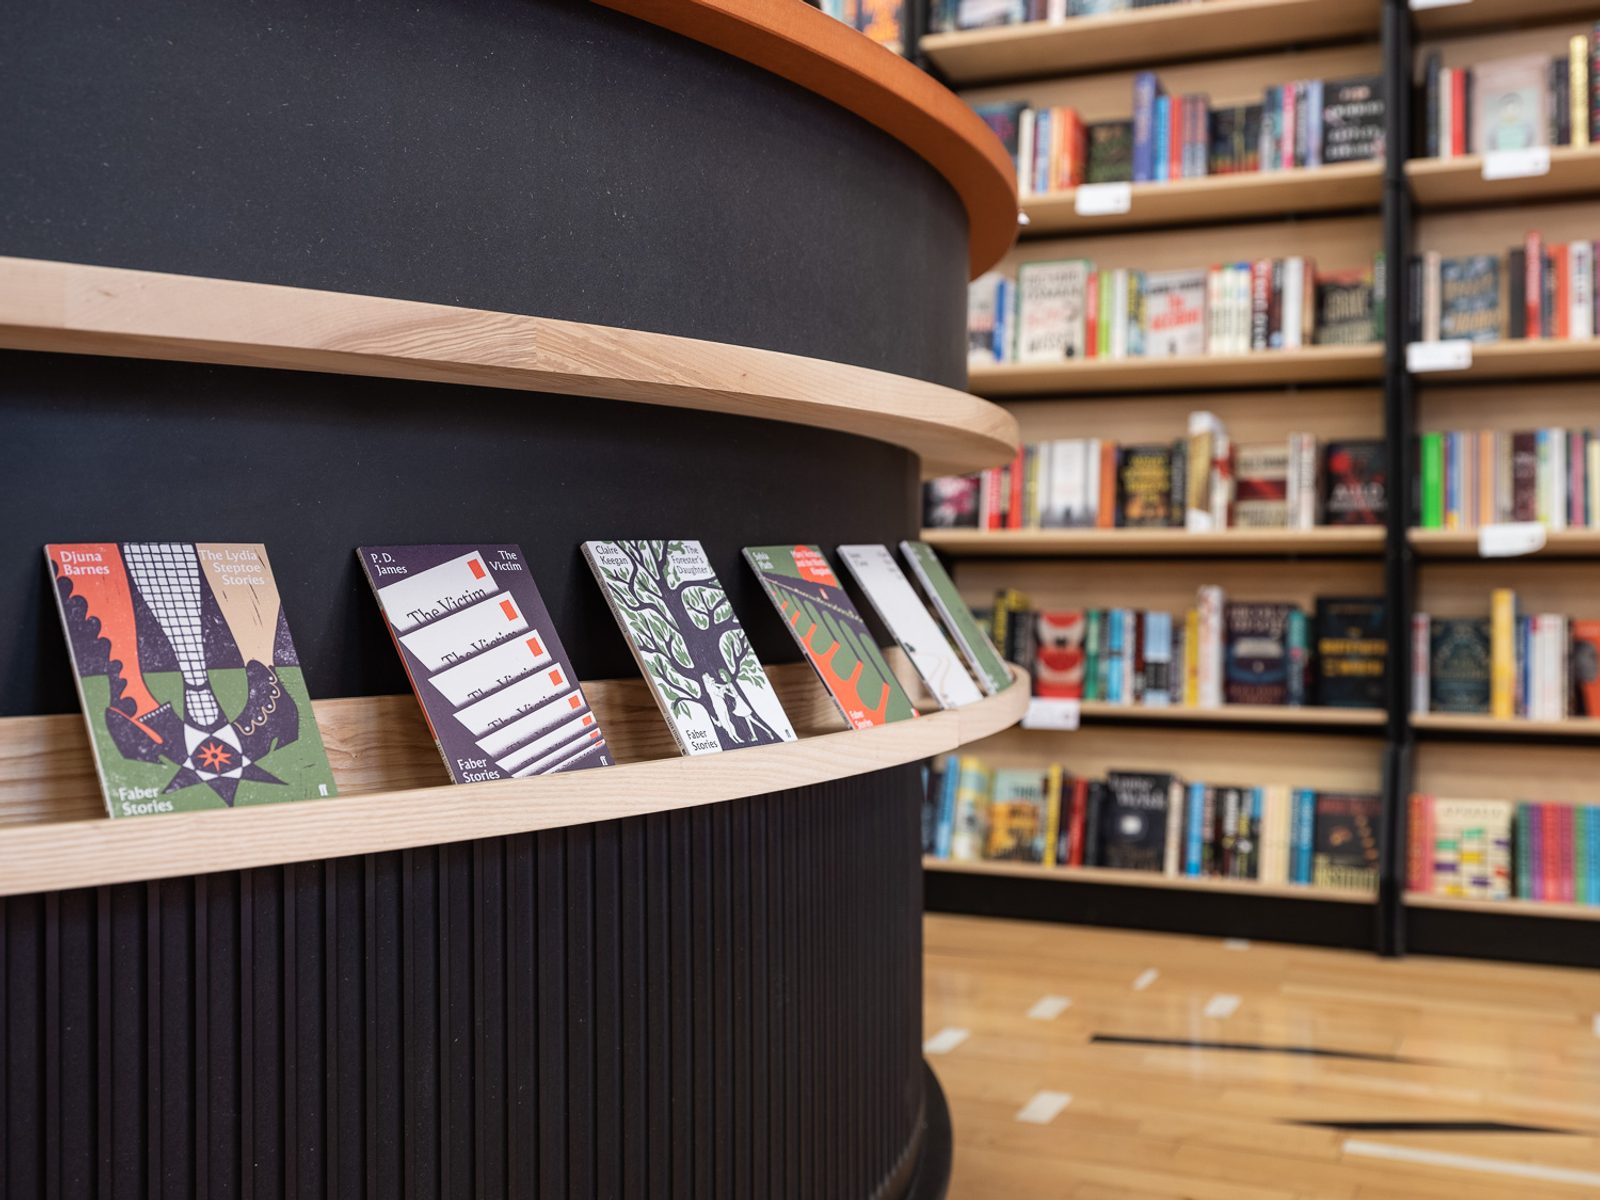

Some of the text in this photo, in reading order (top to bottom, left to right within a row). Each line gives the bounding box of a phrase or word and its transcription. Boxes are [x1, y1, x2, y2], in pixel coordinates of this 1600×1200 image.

[199, 549, 258, 563] The Lydia
[497, 550, 518, 561] The
[595, 545, 619, 555] Claire
[684, 545, 699, 555] The
[60, 551, 103, 563] Djuna
[370, 552, 396, 564] P. D.
[599, 555, 629, 567] Keegan
[64, 563, 110, 575] Barnes
[213, 562, 261, 574] Steptoe
[375, 564, 408, 576] James
[489, 561, 522, 571] Victim
[676, 565, 708, 577] Daughter
[221, 574, 265, 586] Stories
[407, 588, 488, 625] The Victim
[686, 729, 708, 740] Faber
[691, 740, 718, 751] Stories
[457, 757, 487, 770] Faber
[462, 770, 500, 783] Stories
[118, 786, 159, 801] Faber
[122, 799, 174, 816] Stories
